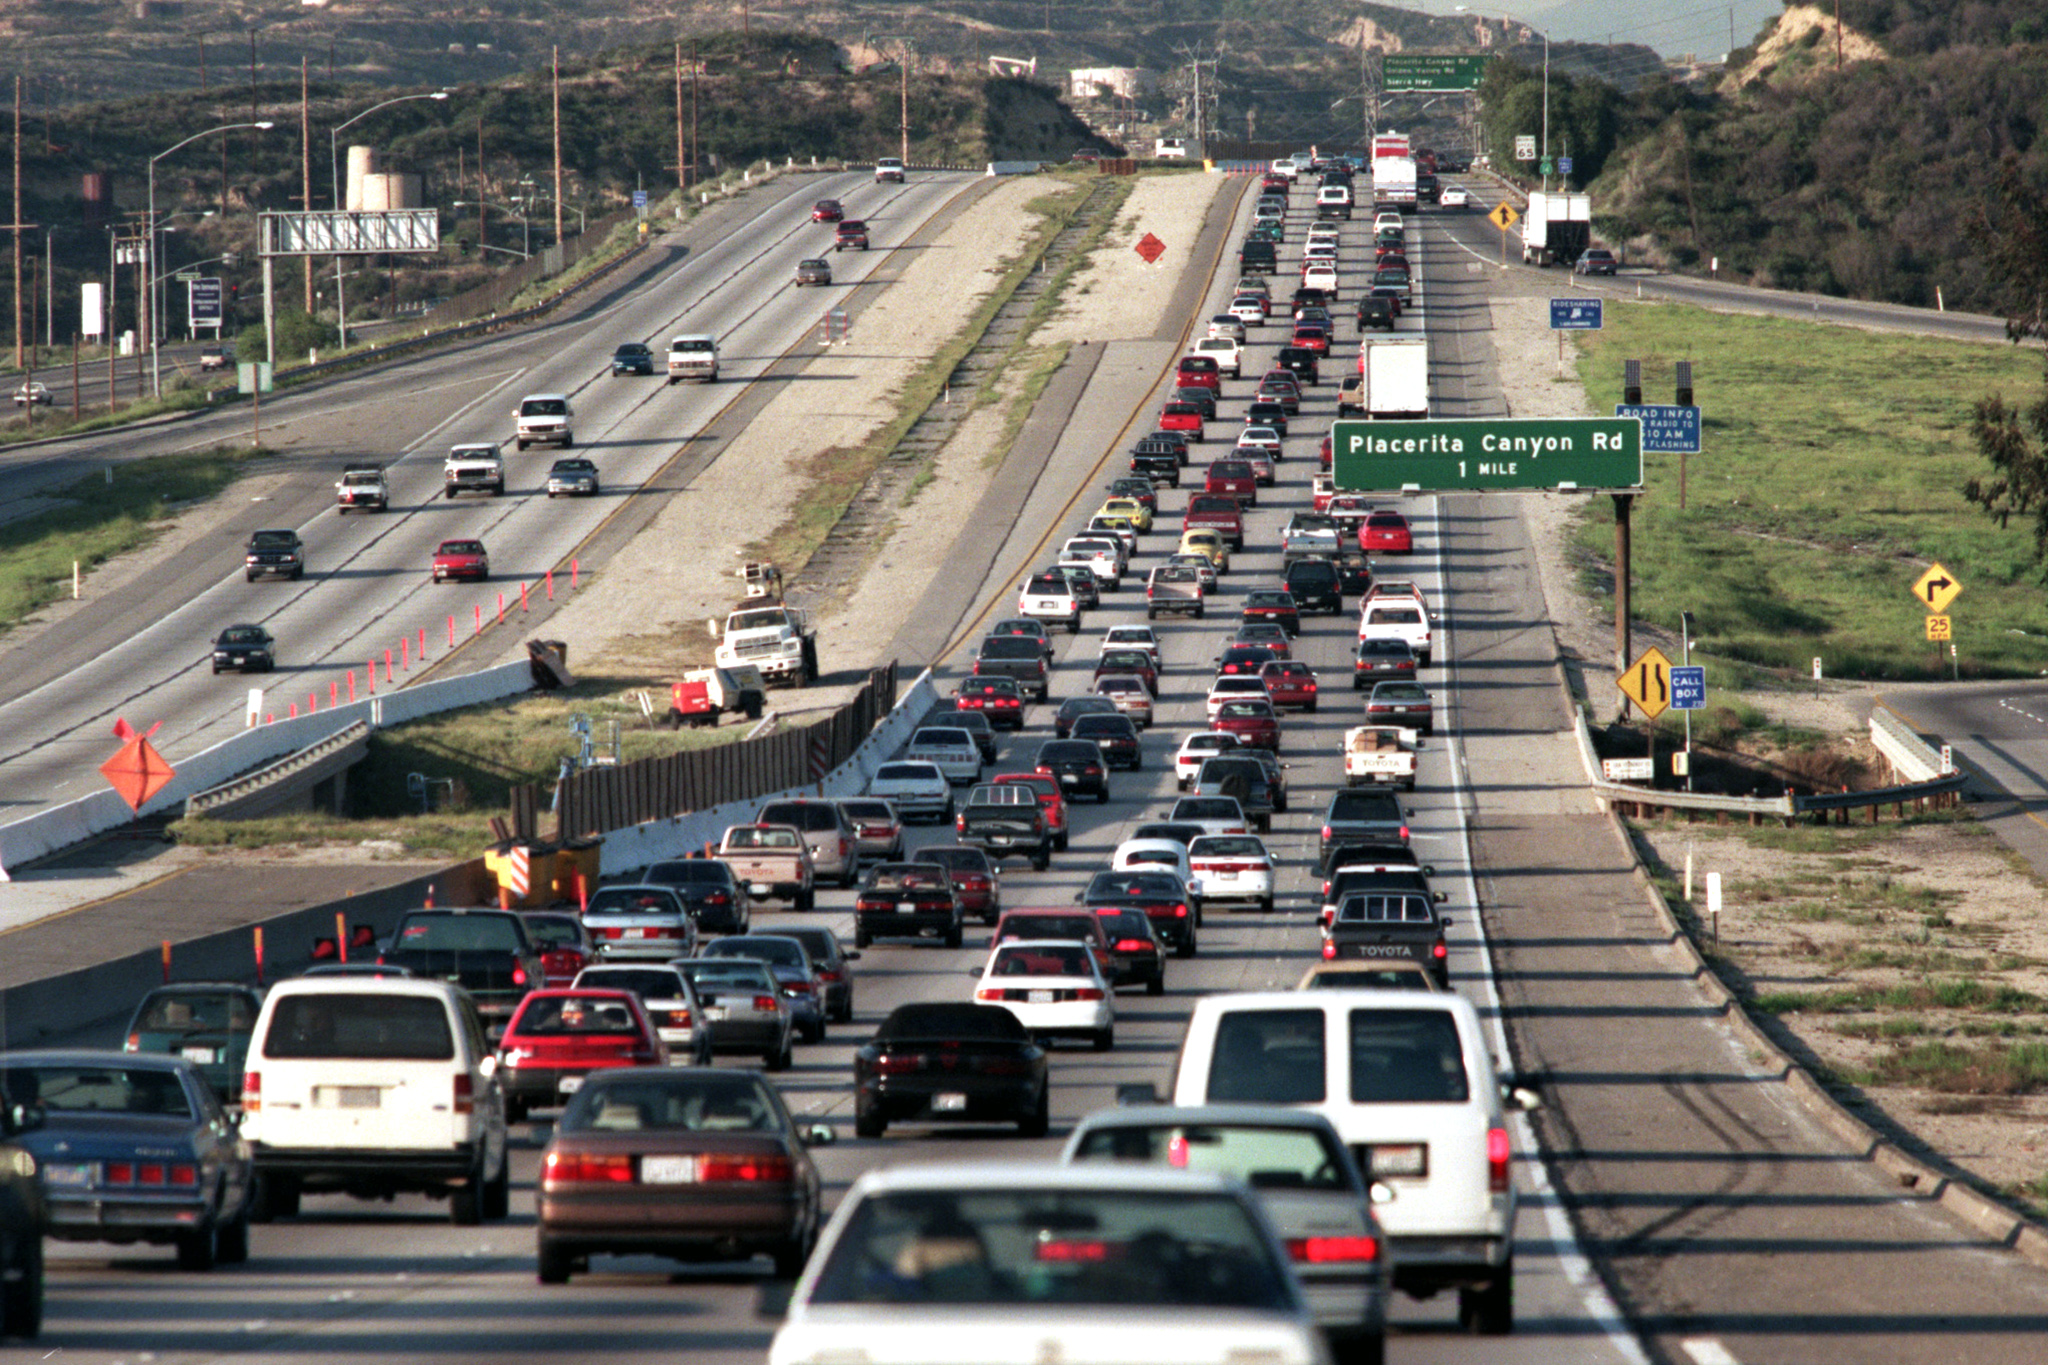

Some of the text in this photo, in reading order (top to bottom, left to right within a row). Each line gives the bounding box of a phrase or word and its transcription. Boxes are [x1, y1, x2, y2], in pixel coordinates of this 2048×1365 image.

[1458, 57, 1470, 65] Rd
[1414, 78, 1433, 87] Hwy
[1518, 148, 1534, 158] 65
[1623, 408, 1693, 419] ROAD INFO
[1650, 419, 1678, 428] RADIO
[1682, 420, 1693, 428] TO
[1664, 429, 1684, 439] AM
[1350, 434, 1464, 453] Placerita
[1482, 434, 1573, 458] Canyon
[1592, 432, 1623, 450] Rd
[1650, 440, 1695, 449] FLASHING
[1458, 461, 1518, 478] 1 MILE
[1930, 618, 1949, 632] 25
[1672, 677, 1702, 687] CALL
[1676, 688, 1699, 698] BOX
[1362, 759, 1400, 767] TOYOTA
[739, 868, 774, 876] TOYOTA
[1358, 945, 1412, 957] TOYOTA
